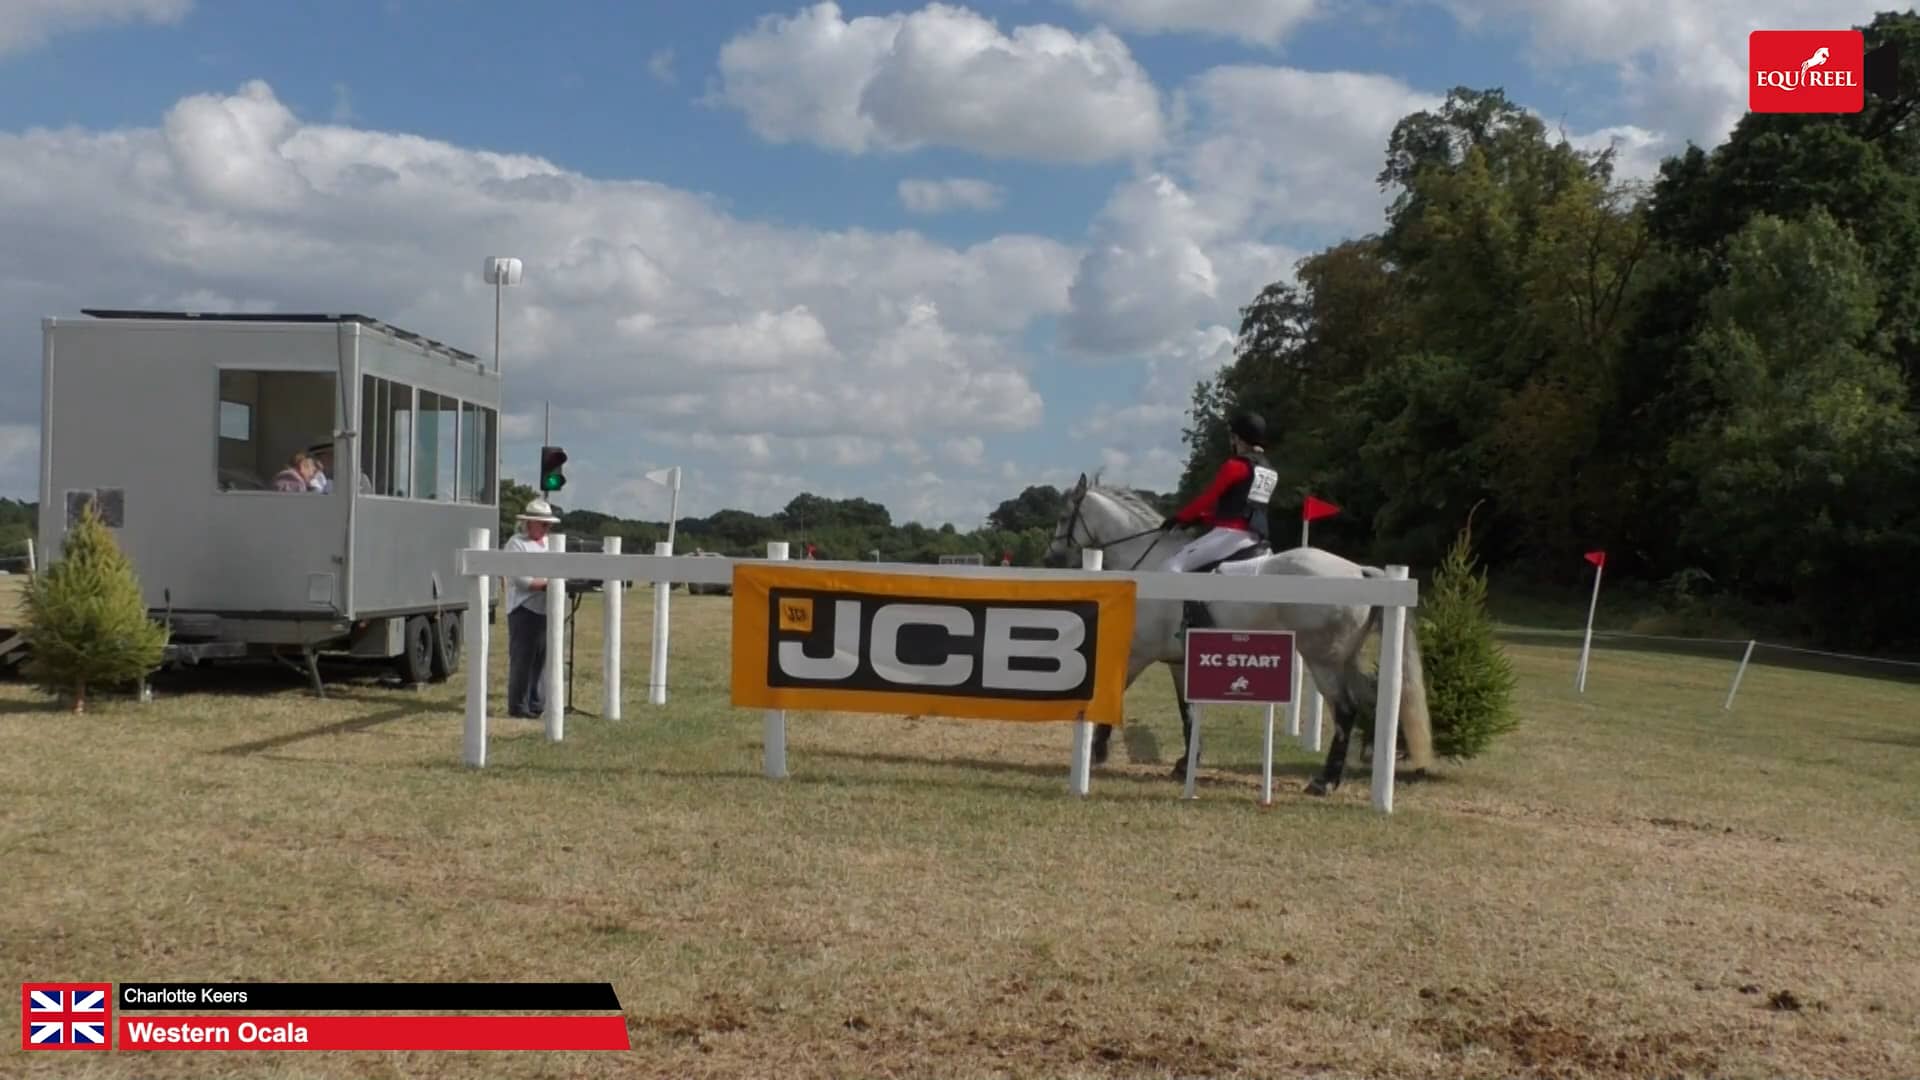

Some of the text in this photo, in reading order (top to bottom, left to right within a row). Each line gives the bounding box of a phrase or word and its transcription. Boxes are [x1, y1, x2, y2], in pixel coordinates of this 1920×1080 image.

[778, 599, 1087, 692] JCB
[1200, 653, 1280, 668] XC START
